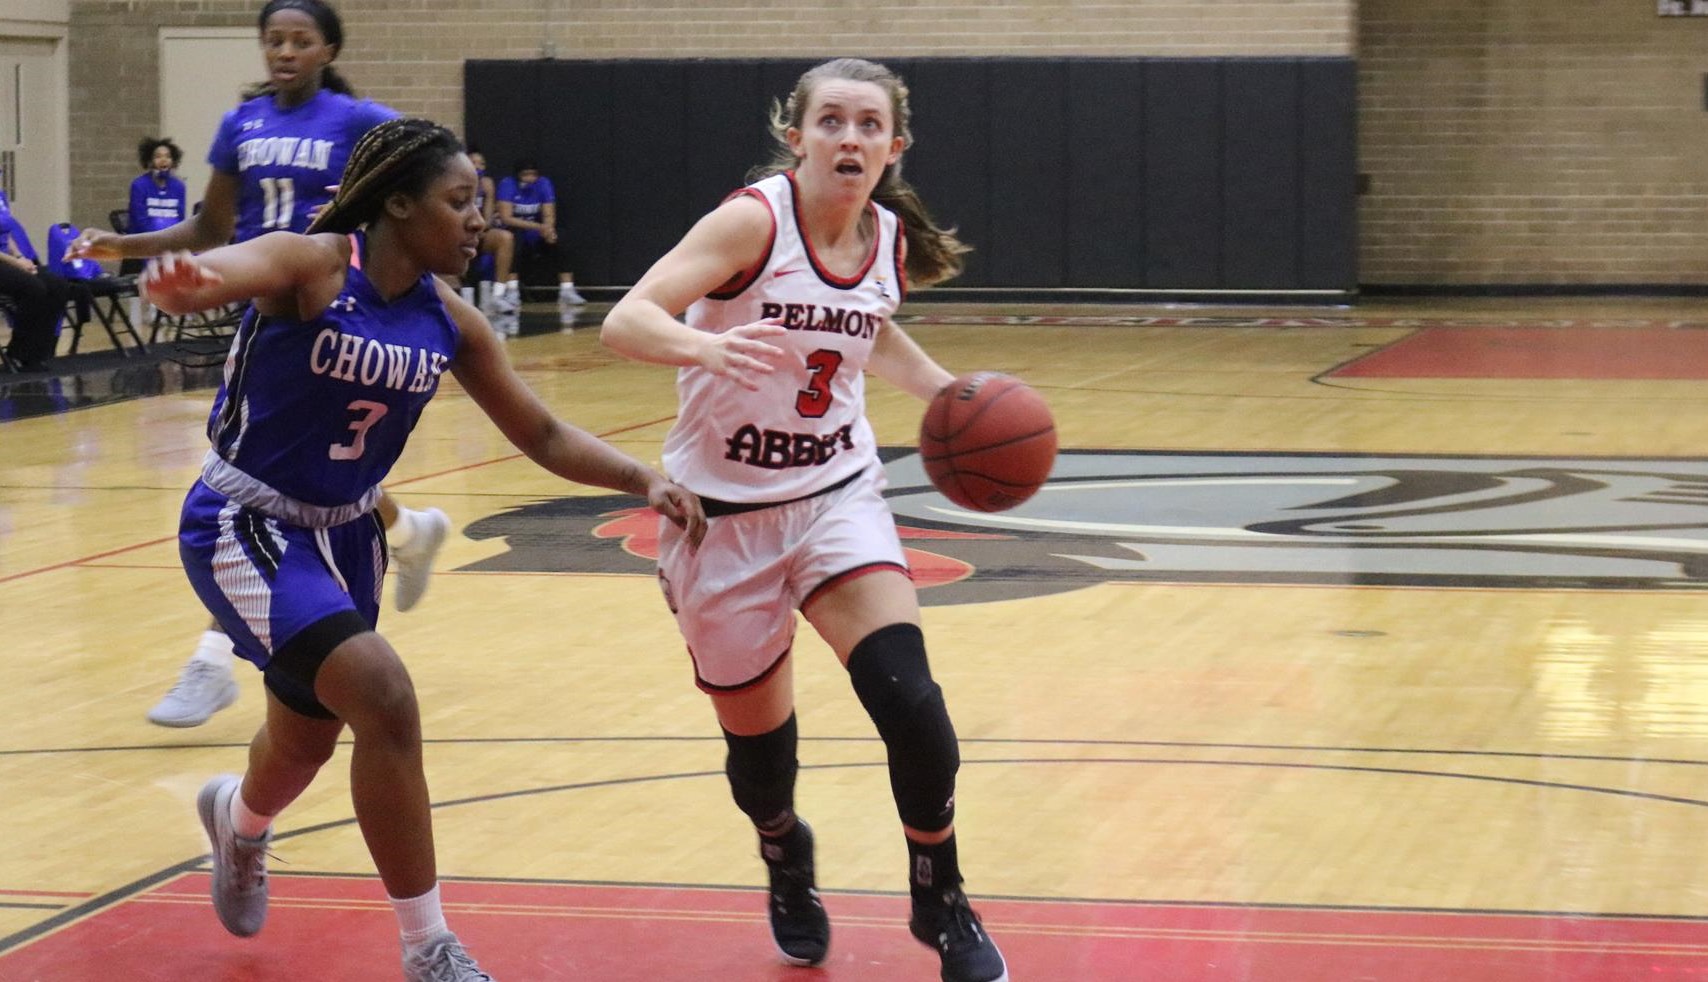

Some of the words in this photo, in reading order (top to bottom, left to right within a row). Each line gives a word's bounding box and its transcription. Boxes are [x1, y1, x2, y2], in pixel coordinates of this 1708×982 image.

[237, 136, 334, 171] CHOWAN
[259, 178, 294, 229] 11
[795, 348, 843, 418] 3
[328, 399, 388, 460] 3
